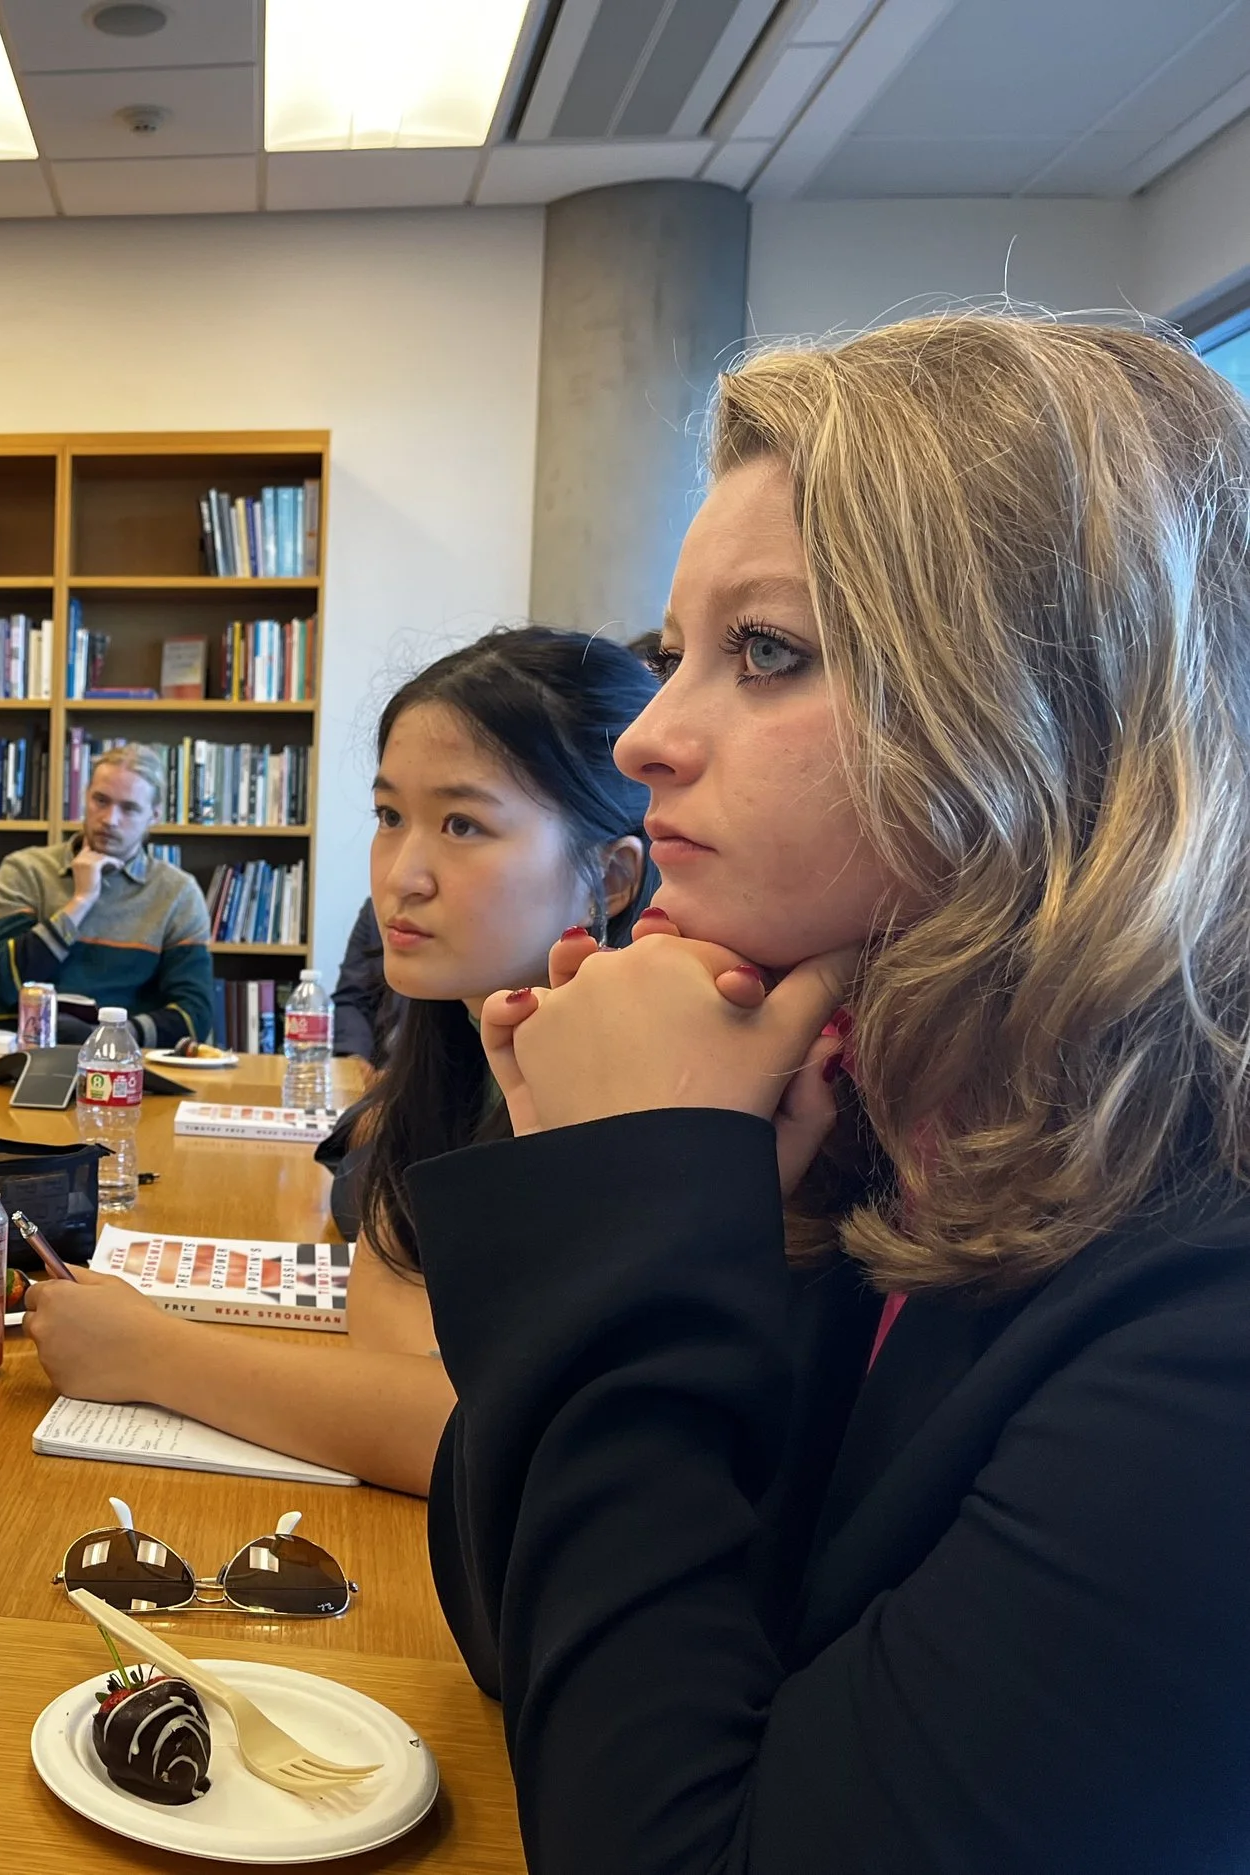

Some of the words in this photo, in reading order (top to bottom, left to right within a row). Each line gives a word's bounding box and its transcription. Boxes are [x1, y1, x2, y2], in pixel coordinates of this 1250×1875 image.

[110, 1248, 126, 1269] WEAK
[179, 1242, 196, 1270] LIMITS
[213, 1247, 228, 1275] POWER
[175, 1274, 190, 1289] THE
[211, 1278, 224, 1290] OF
[282, 1258, 295, 1290] RUSSIA
[317, 1255, 331, 1295] TIMOTHY
[246, 1286, 258, 1295] IN
[164, 1303, 196, 1313] FRYE
[215, 1307, 250, 1317] WEAK
[257, 1310, 342, 1324] STRONGMAN
